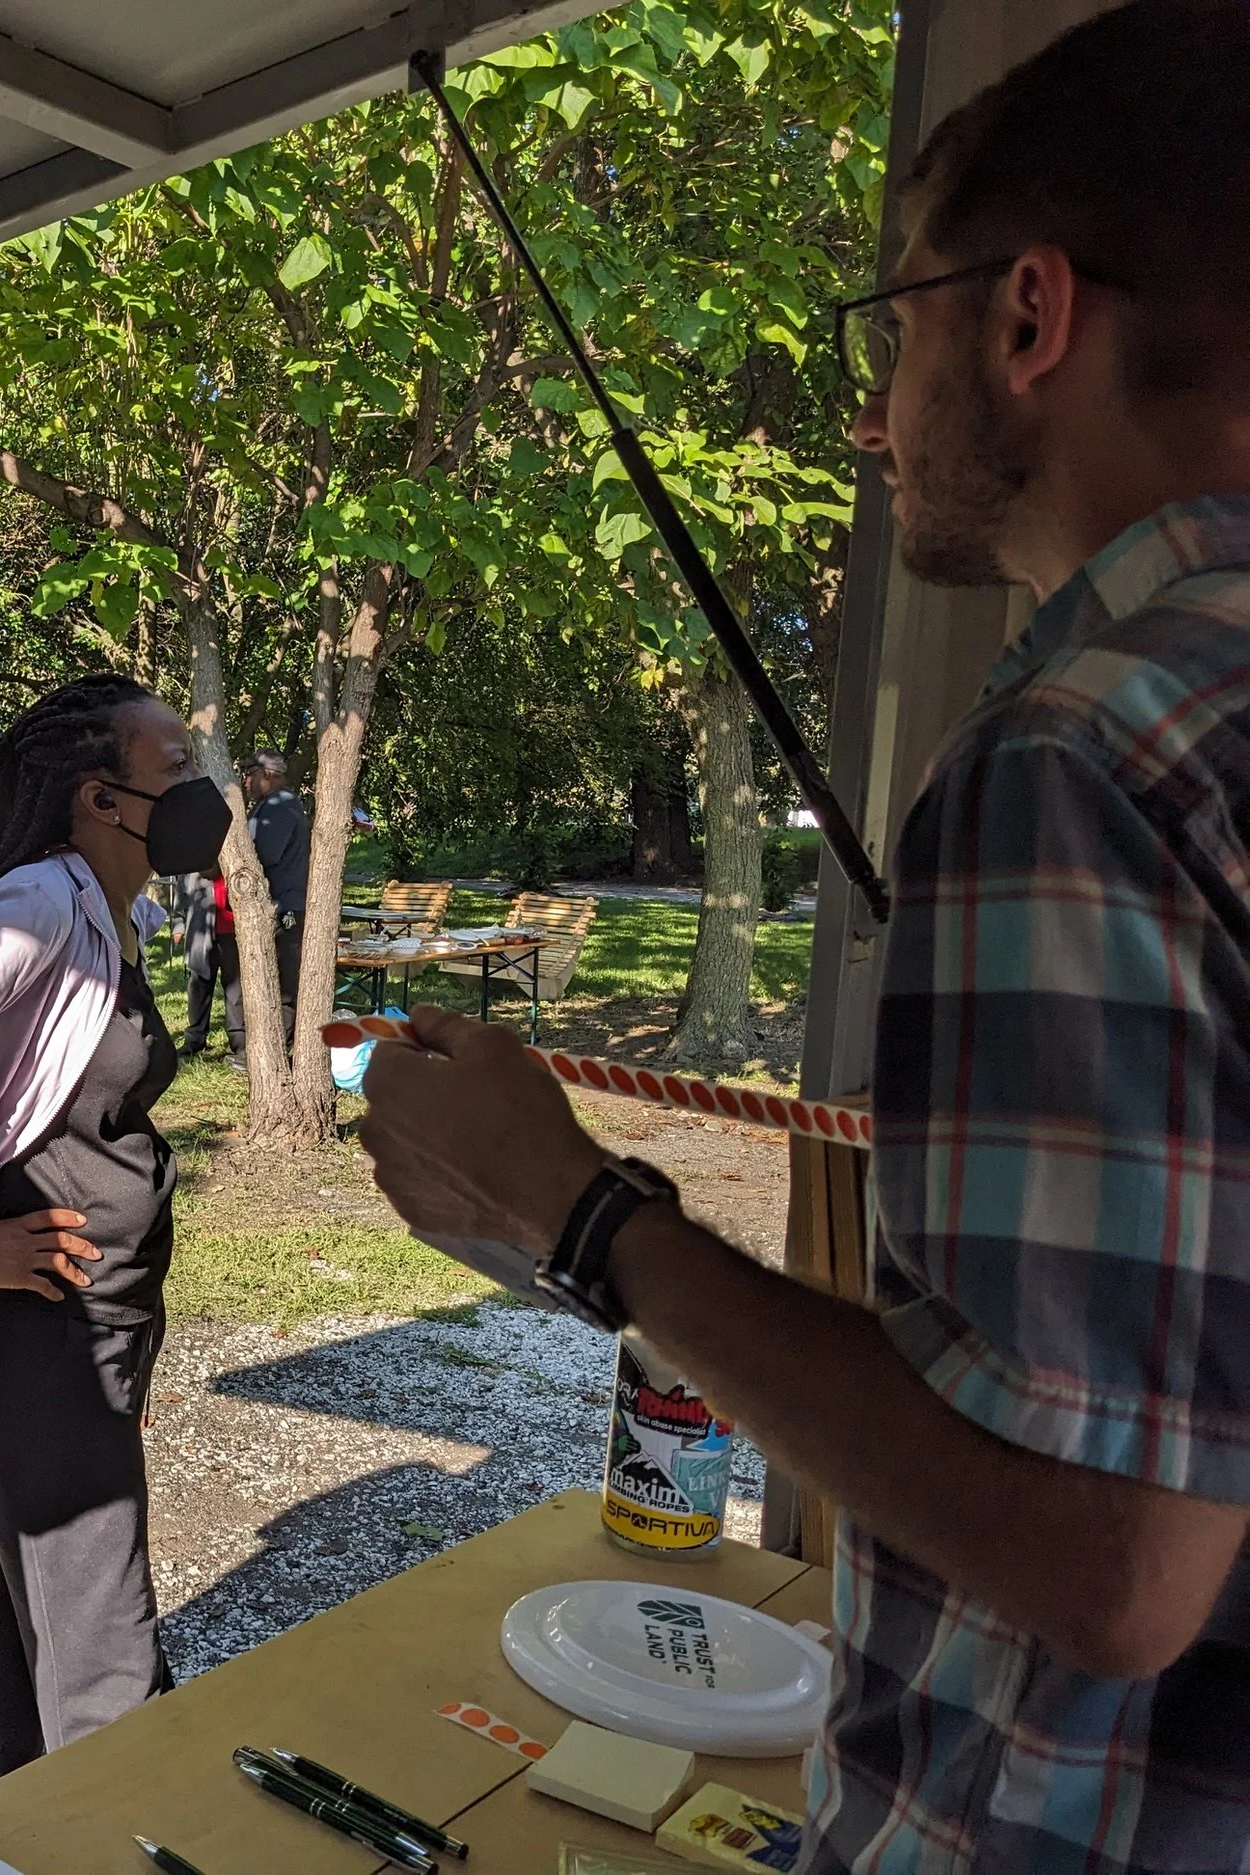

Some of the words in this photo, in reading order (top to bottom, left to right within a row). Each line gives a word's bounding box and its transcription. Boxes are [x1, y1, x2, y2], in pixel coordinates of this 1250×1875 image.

[650, 1418, 673, 1431] abuse
[674, 1424, 707, 1436] specialist
[610, 1467, 679, 1502] maxim
[607, 1503, 715, 1536] SPORTIVA
[649, 1499, 690, 1513] ROPES
[644, 1624, 665, 1660] LAND
[668, 1628, 692, 1674] PUBLIC
[692, 1634, 715, 1674] TRUST
